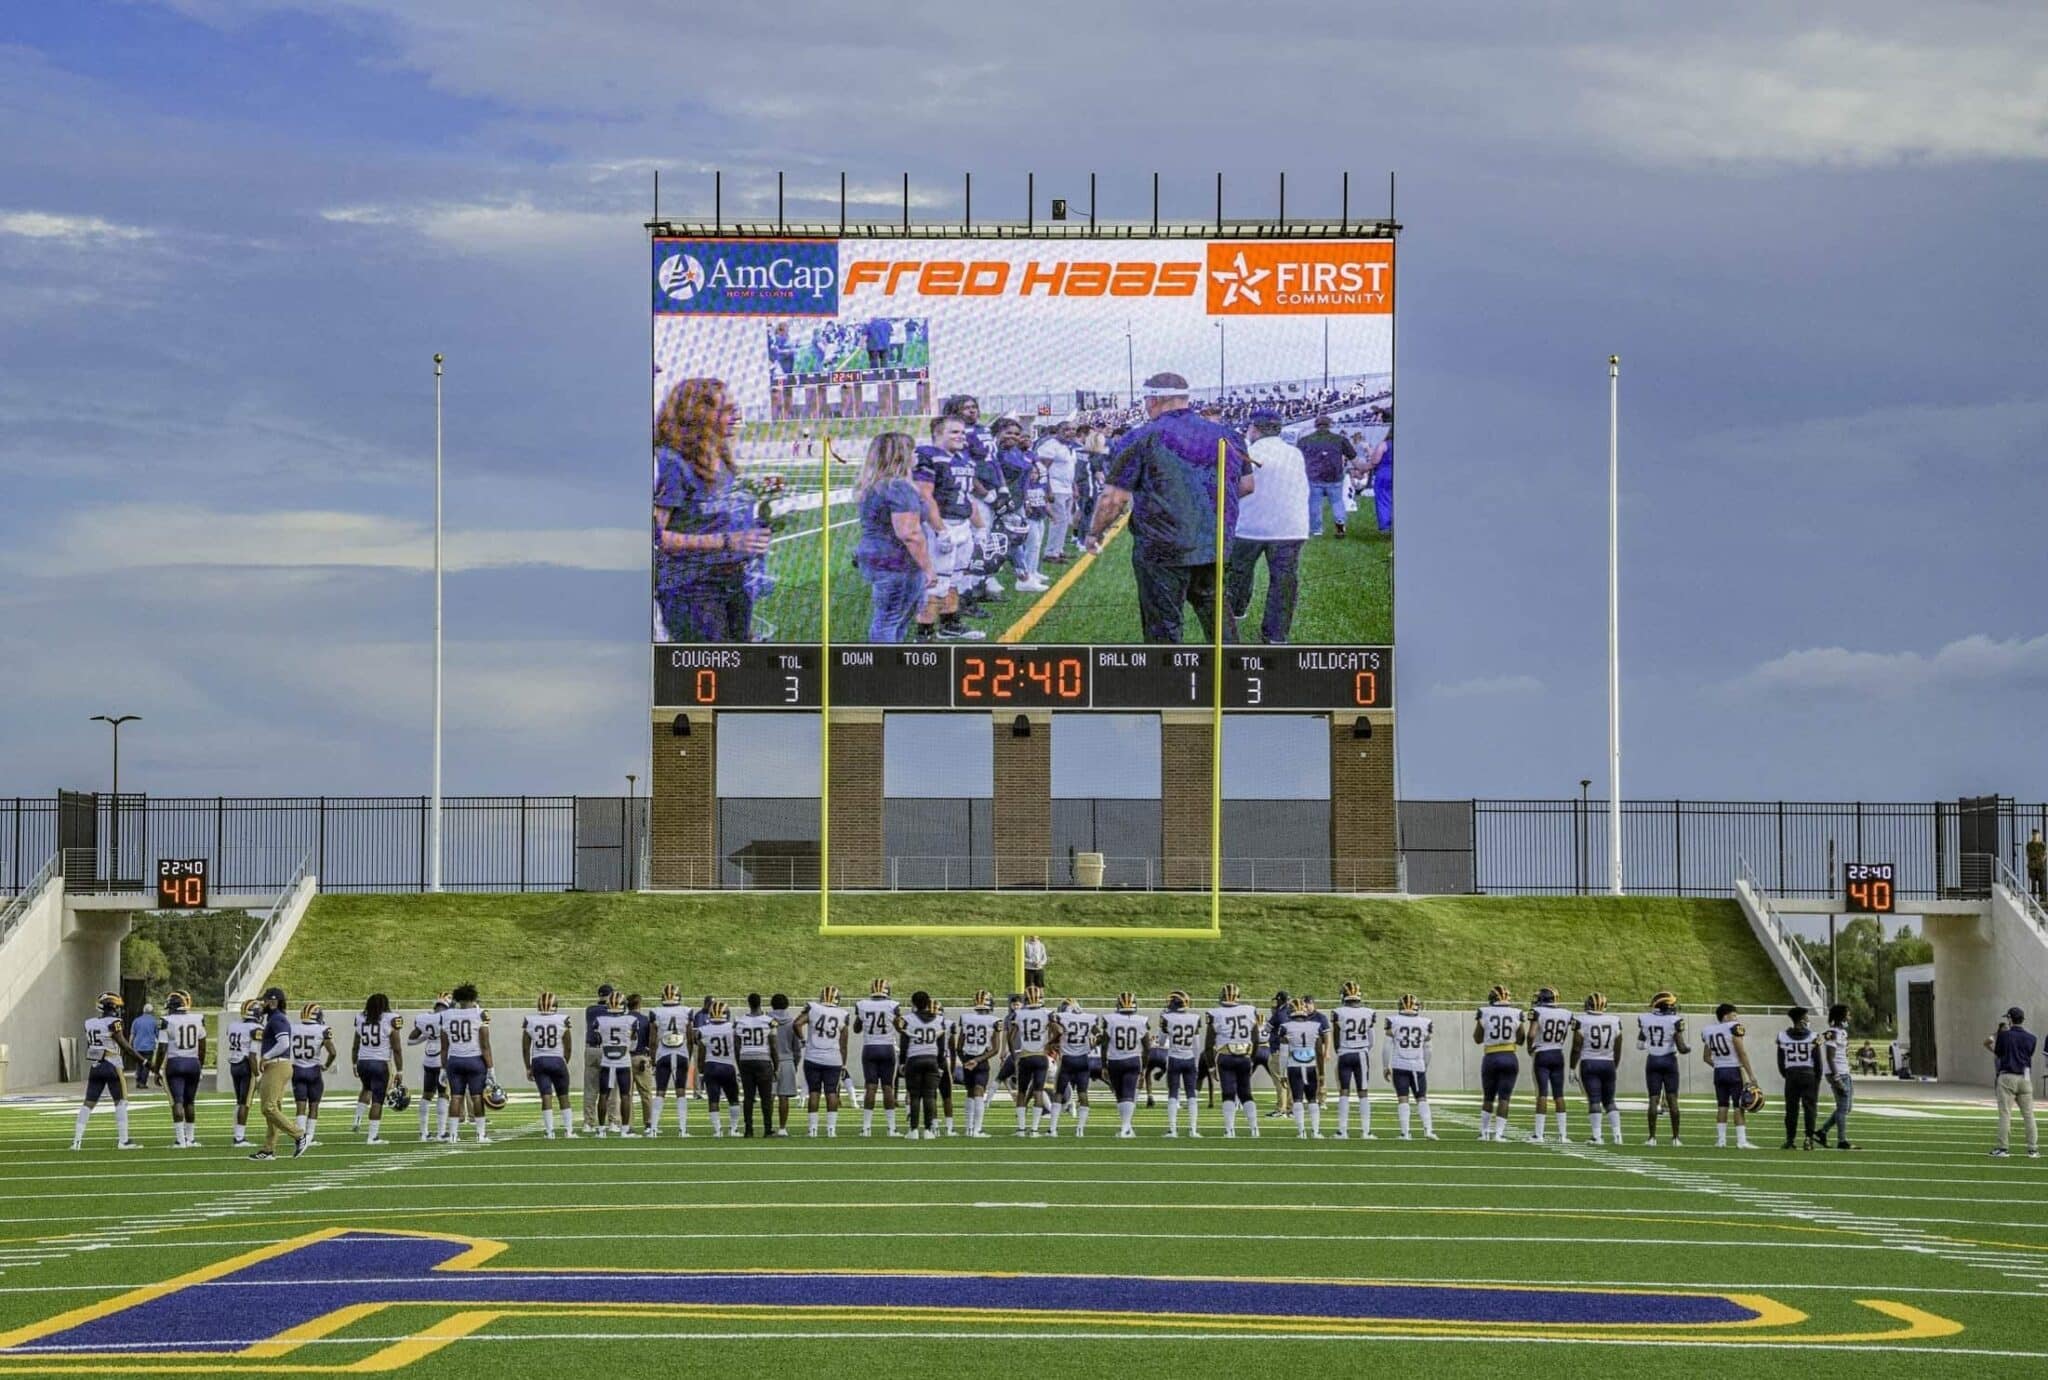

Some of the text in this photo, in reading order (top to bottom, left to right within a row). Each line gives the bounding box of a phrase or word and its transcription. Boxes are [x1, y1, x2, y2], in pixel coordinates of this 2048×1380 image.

[708, 258, 834, 297] AmCap
[1276, 262, 1389, 292] FIRST
[1276, 293, 1385, 305] COMMUNITY
[671, 651, 741, 668] COUGARS
[779, 656, 802, 669] TOL
[842, 652, 873, 666] DOWN
[904, 652, 937, 666] TO GO
[1100, 653, 1146, 666] BALL ON
[1174, 653, 1199, 666] QTR
[1241, 657, 1264, 670] TOL
[1298, 652, 1380, 669] WILDCATS
[696, 670, 716, 702] 0
[785, 676, 799, 702] 3
[962, 658, 1080, 697] 22:40
[1191, 672, 1196, 700] 1
[1356, 672, 1375, 704] 0
[1248, 678, 1261, 703] 3
[161, 861, 203, 875] 22:40
[1849, 865, 1892, 879] 22:40
[163, 878, 201, 904] 40
[1851, 882, 1890, 909] 40
[361, 1022, 380, 1047] 59
[450, 1019, 472, 1043] 90
[668, 1016, 678, 1034] 4
[815, 1014, 839, 1039] 43
[865, 1011, 887, 1035] 74
[1023, 1018, 1041, 1042] 12
[1067, 1022, 1089, 1044] 27
[1225, 1015, 1249, 1040] 75
[1345, 1018, 1367, 1041] 24
[1489, 1015, 1513, 1040] 36
[1543, 1019, 1565, 1042] 86
[177, 1024, 197, 1050] 10
[535, 1024, 557, 1049] 38
[610, 1027, 620, 1045] 5
[710, 1036, 730, 1057] 31
[742, 1028, 763, 1046] 20
[966, 1024, 987, 1046] 23
[1115, 1026, 1137, 1051] 60
[1172, 1024, 1194, 1047] 22
[1300, 1032, 1306, 1048] 1
[1399, 1026, 1422, 1049] 33
[1590, 1025, 1612, 1049] 97
[1648, 1025, 1664, 1047] 17
[1709, 1033, 1730, 1057] 40
[292, 1035, 315, 1060] 25
[1786, 1042, 1809, 1062] 29
